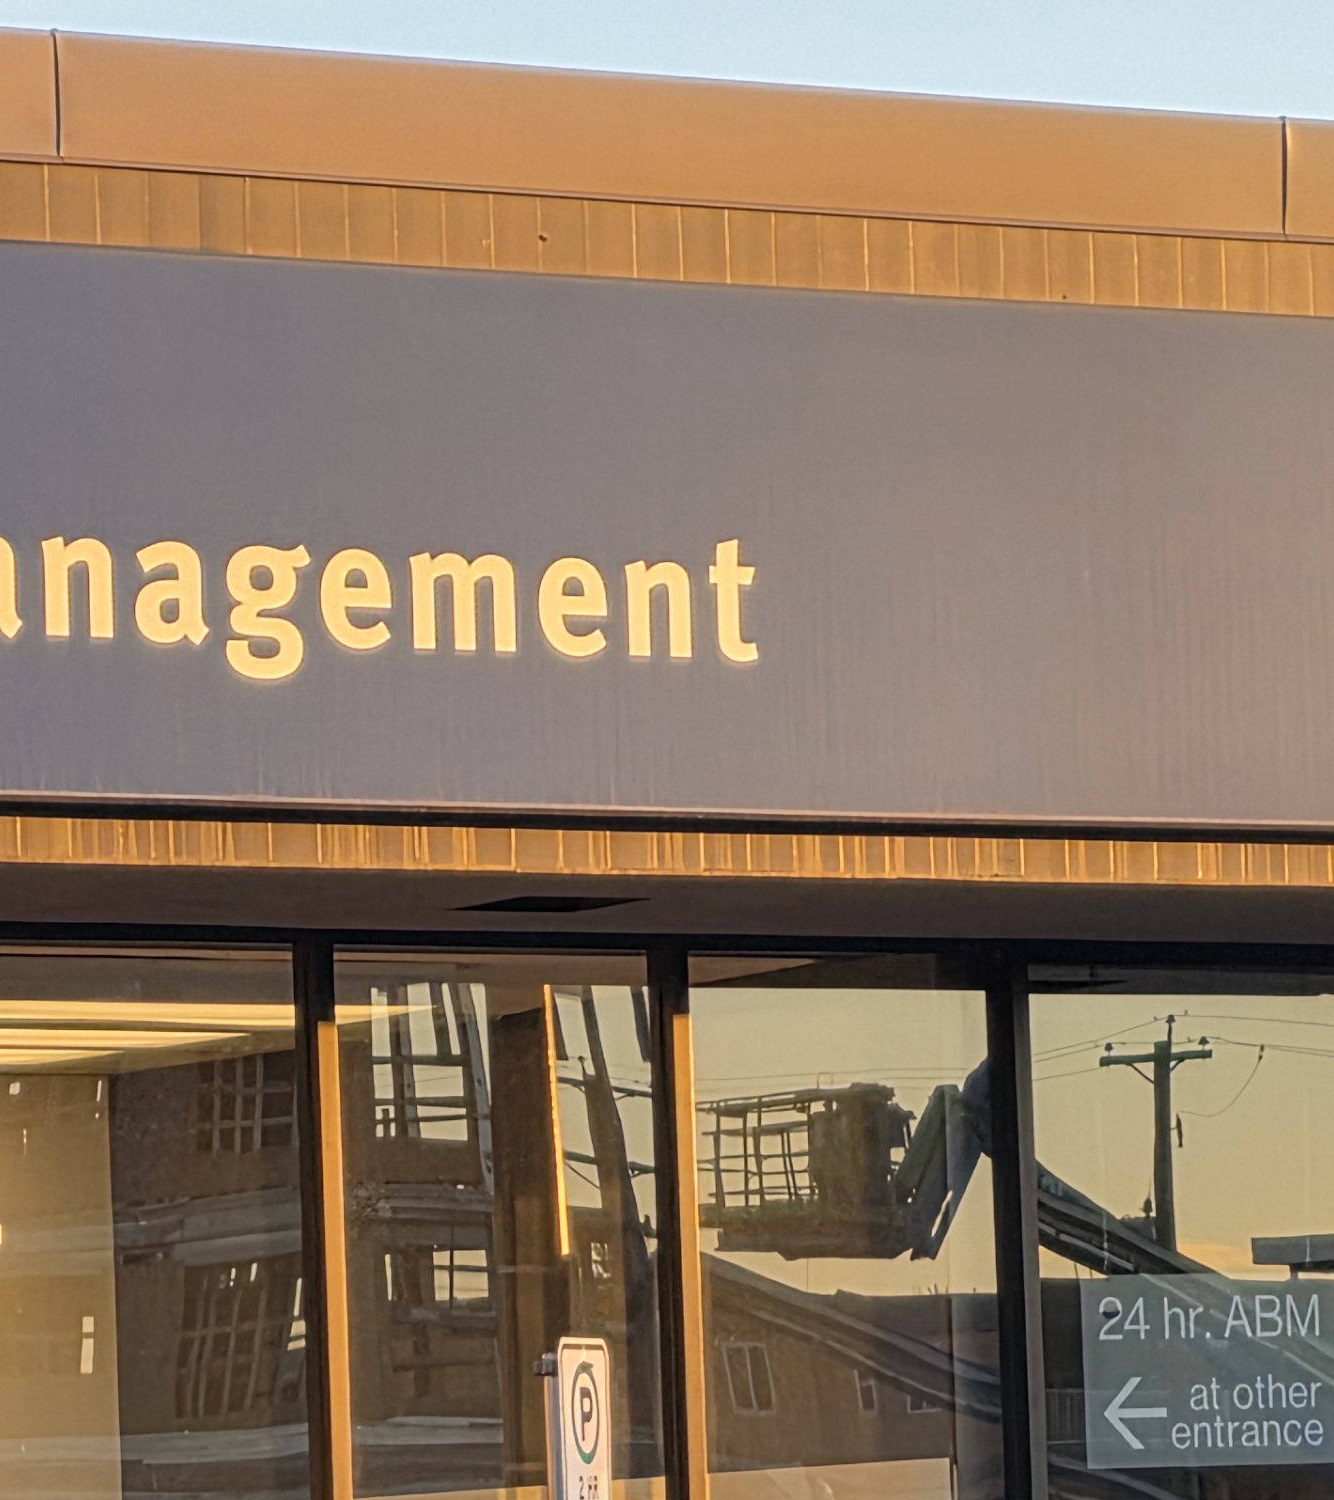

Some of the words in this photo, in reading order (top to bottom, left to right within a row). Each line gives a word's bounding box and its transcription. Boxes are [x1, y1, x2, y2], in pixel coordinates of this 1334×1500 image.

[1099, 1296, 1151, 1341] 24
[1163, 1296, 1211, 1340] hr.
[1224, 1293, 1320, 1338] ABM
[1189, 1376, 1220, 1411] at
[1232, 1373, 1323, 1411] other
[1170, 1414, 1324, 1450] entrance
[578, 1475, 585, 1500] 2
